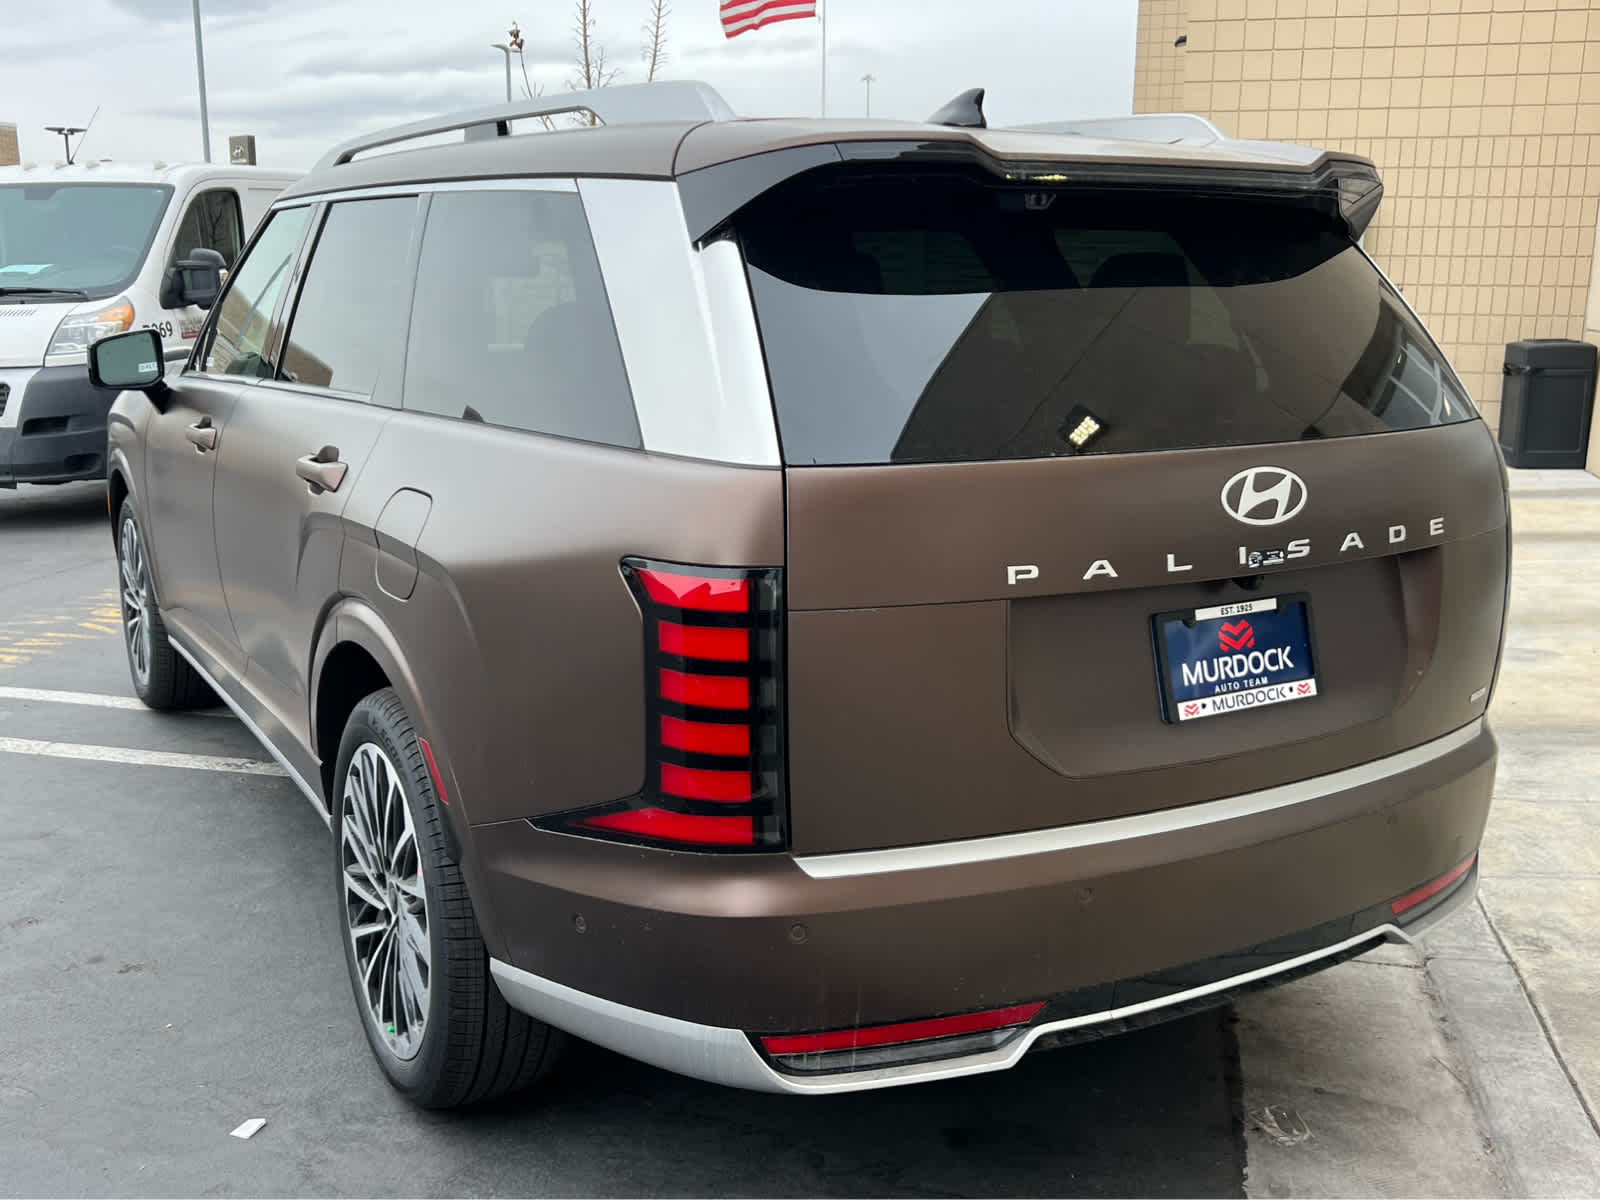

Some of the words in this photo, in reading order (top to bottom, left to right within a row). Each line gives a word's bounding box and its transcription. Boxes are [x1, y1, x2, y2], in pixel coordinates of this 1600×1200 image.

[142, 320, 173, 338] 69
[1007, 517, 1445, 585] PALISADE
[1236, 603, 1253, 613] 1925
[1181, 646, 1294, 687] MURDOCK
[1215, 681, 1240, 694] AUTO
[1243, 676, 1269, 688] TEAM
[1212, 686, 1287, 712] MURDOCK
